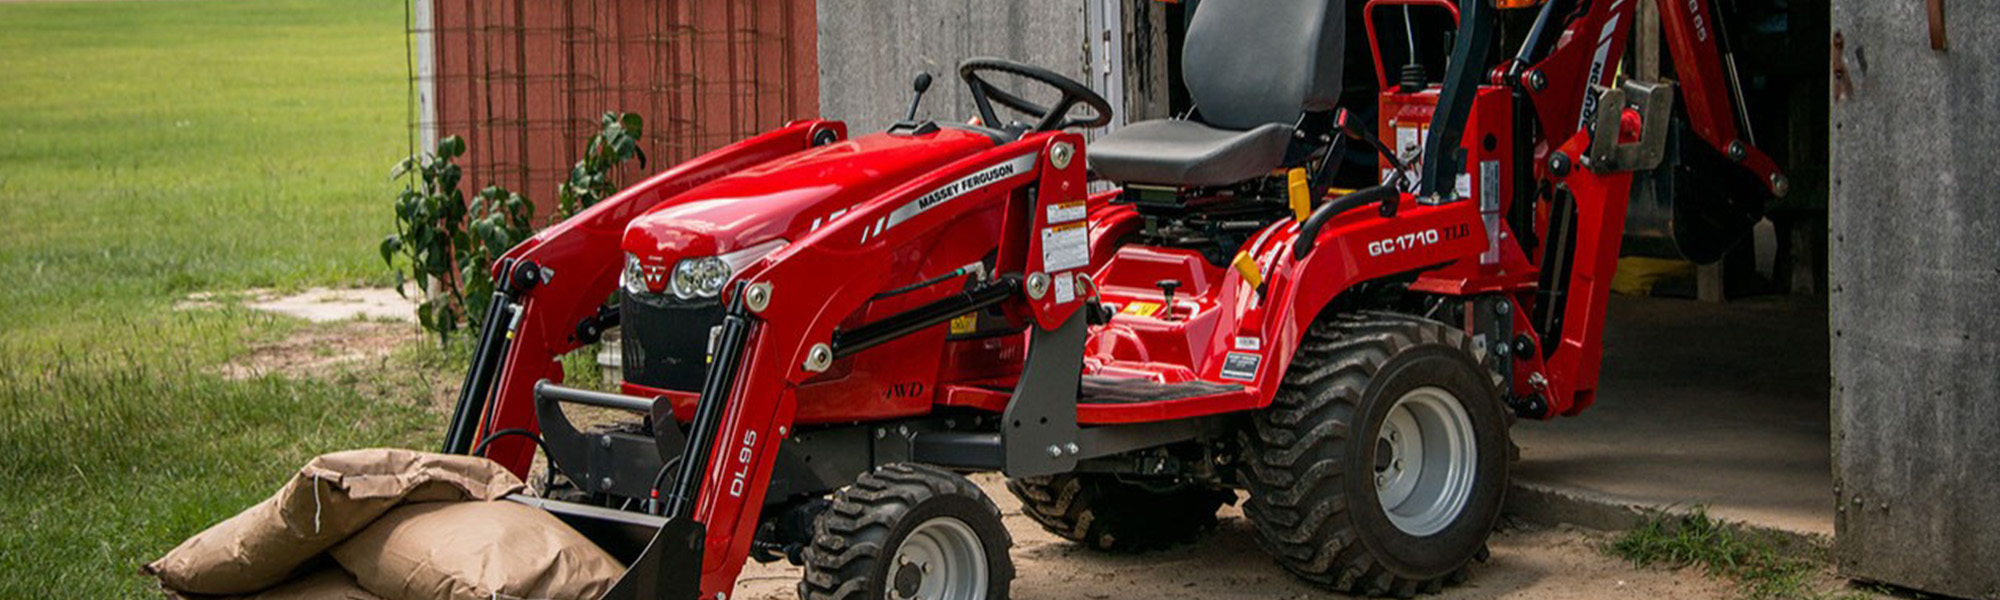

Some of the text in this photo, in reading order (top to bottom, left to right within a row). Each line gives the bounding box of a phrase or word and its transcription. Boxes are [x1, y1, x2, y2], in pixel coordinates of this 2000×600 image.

[918, 163, 1014, 209] MASSEY FERGUSON
[1368, 229, 1438, 256] GC1710
[1444, 222, 1470, 240] TLB
[730, 429, 757, 497] DL95
